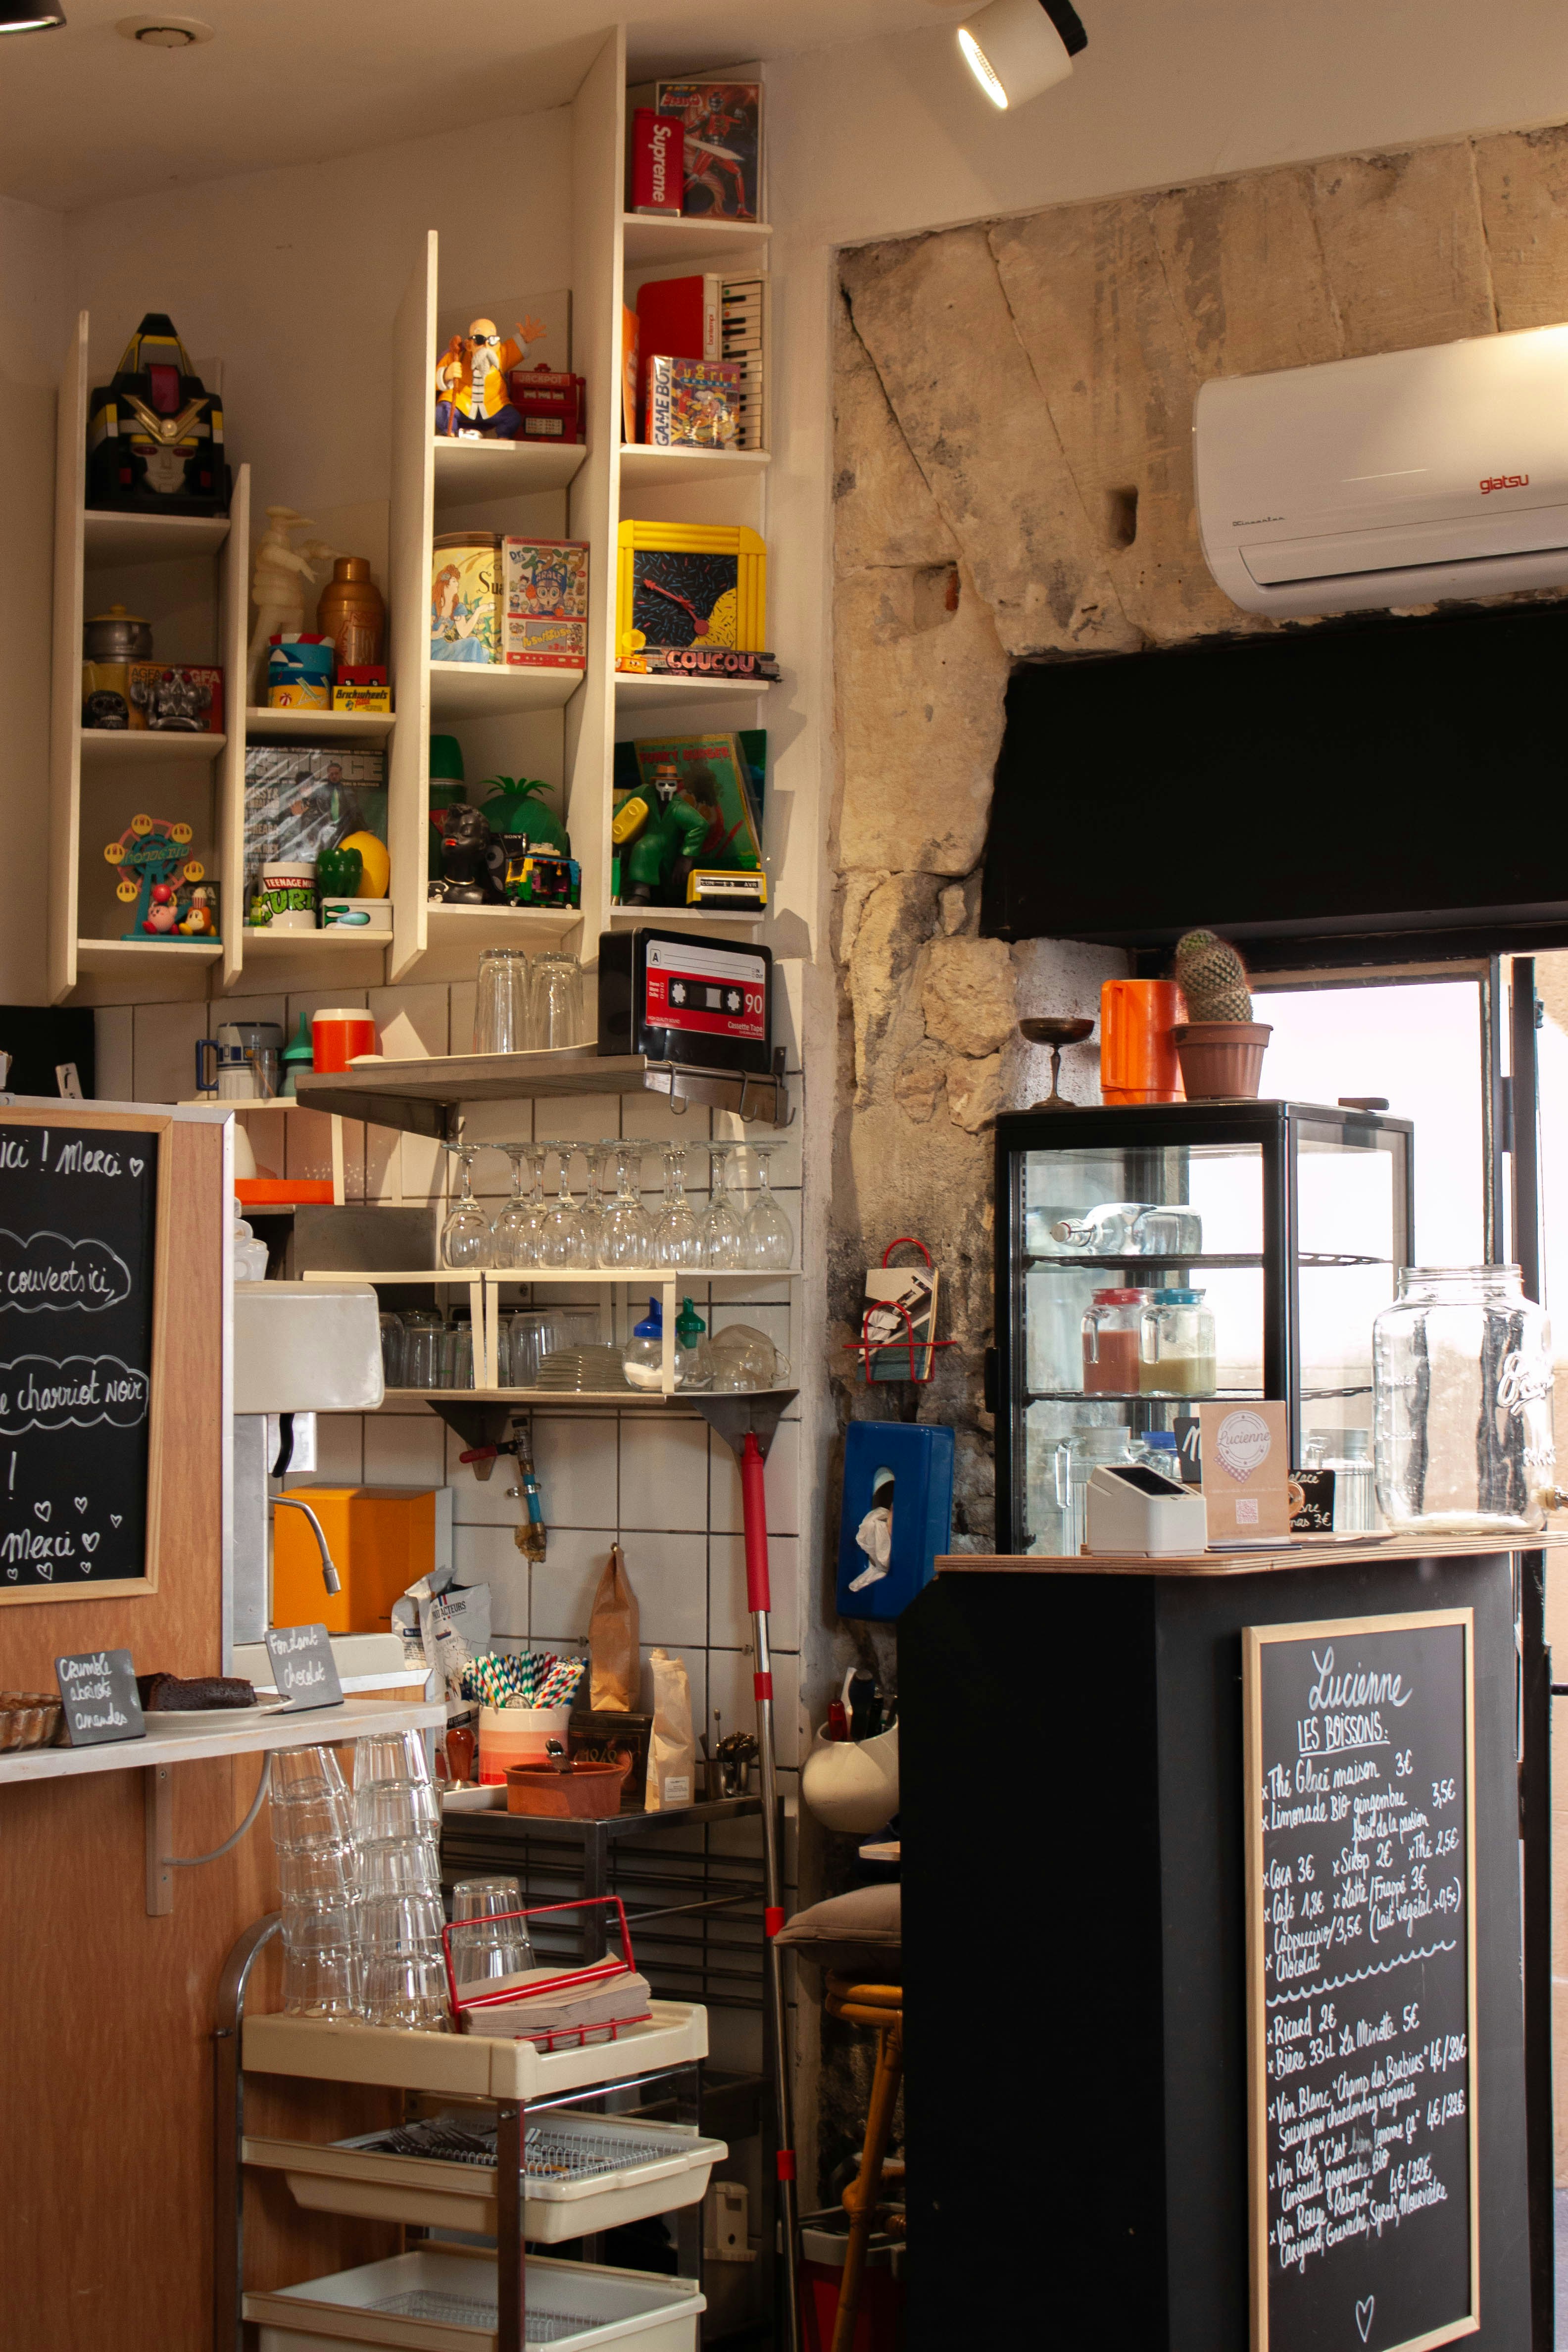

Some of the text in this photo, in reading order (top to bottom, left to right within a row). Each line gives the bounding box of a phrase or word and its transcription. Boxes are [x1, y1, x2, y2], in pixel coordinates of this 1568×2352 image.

[647, 124, 671, 203] Supreme
[655, 364, 670, 446] GAME BOY
[1479, 474, 1529, 494] giatsu
[190, 670, 221, 683] GFA
[667, 650, 755, 673] COUCOU
[265, 879, 302, 888] TEENAGE
[652, 952, 658, 962] A
[745, 993, 763, 1014] 90
[728, 1021, 763, 1032] Cassette Tape
[54, 1140, 122, 1177] Merci
[7, 1261, 86, 1294] couverts
[1216, 1430, 1272, 1448] Lucienne
[1314, 1512, 1332, 1528] 3€
[0, 1528, 76, 1563] Merci
[269, 1626, 318, 1655] Fondant
[59, 1652, 113, 1681] Crumble
[1309, 1646, 1414, 1711] Lucienne
[1297, 1716, 1321, 1753] LES
[1267, 1763, 1292, 1800] Thé
[1295, 1758, 1331, 1794] Glacé
[1332, 1759, 1381, 1789] maison
[1395, 1748, 1413, 1777] 3€
[1271, 1792, 1329, 1830] Limonade
[1330, 1790, 1352, 1821] BIO
[1353, 1782, 1409, 1822] gingembre
[1431, 1777, 1457, 1810] 3,5€
[1388, 1811, 1399, 1833] la
[1399, 1807, 1430, 1845] passion
[1413, 1830, 1433, 1859] Thé
[1435, 1826, 1460, 1857] 2,5€
[1297, 1854, 1316, 1883] 3€
[1375, 1840, 1394, 1868] 2€
[1411, 1863, 1427, 1891] 3€
[1273, 1887, 1295, 1934] Café
[1300, 1890, 1325, 1920] 1,8€
[1396, 1888, 1433, 1938] végétal
[1276, 1948, 1321, 1982] Chocolat
[1274, 2004, 1313, 2046] Ricard
[1318, 2003, 1337, 2033] 2€
[1274, 2045, 1307, 2081] Bière
[1338, 2024, 1357, 2057] La
[1356, 2010, 1398, 2048] Minotte
[1403, 2002, 1421, 2032] 5€
[1276, 2091, 1298, 2125] Vin
[1298, 2084, 1333, 2118] Blanc
[1278, 2114, 1326, 2156] Sauvignon
[1276, 2157, 1294, 2188] Vin
[1295, 2147, 1320, 2179] Rosé
[1281, 2163, 1324, 2212] Cinsault
[1372, 2146, 1390, 2175] BIO
[1399, 2175, 1449, 2216] Mourvèdre
[1276, 2216, 1295, 2246] Vin
[1296, 2204, 1328, 2239] Rouge
